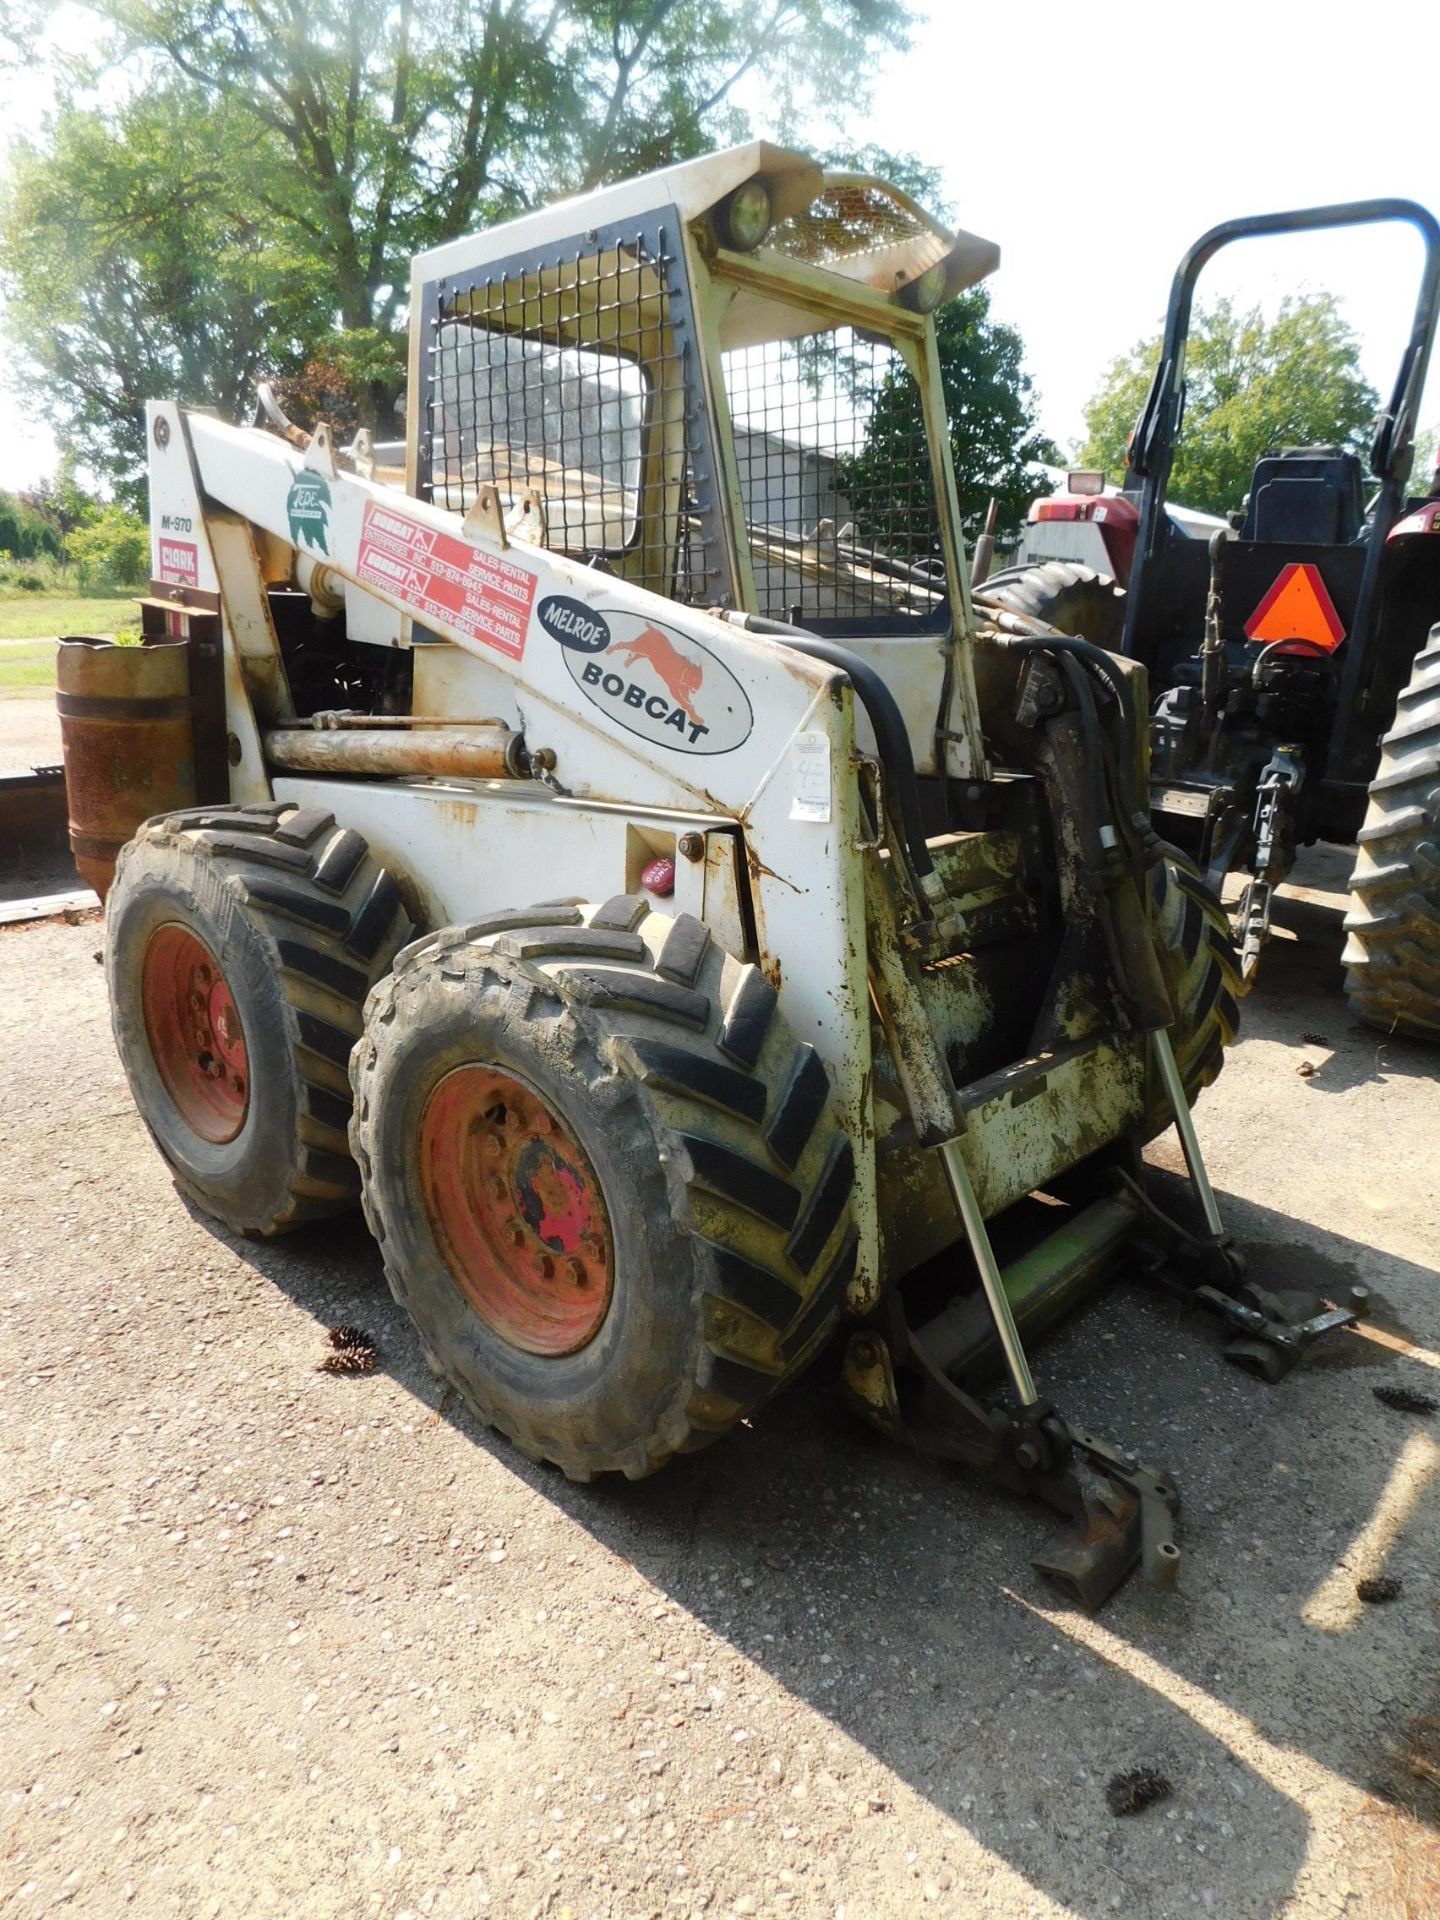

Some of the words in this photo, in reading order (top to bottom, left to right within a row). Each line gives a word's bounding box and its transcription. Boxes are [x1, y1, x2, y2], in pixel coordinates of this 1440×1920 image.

[161, 514, 192, 533] M-970
[372, 513, 414, 540] BOBCAT
[364, 528, 408, 557] ENTERPRISES
[162, 546, 195, 572] CLARK
[366, 551, 408, 579] BOBCAT
[358, 568, 402, 598] ENTERPRISES
[544, 602, 602, 646] MELROE
[581, 661, 710, 745] BOBCAT
